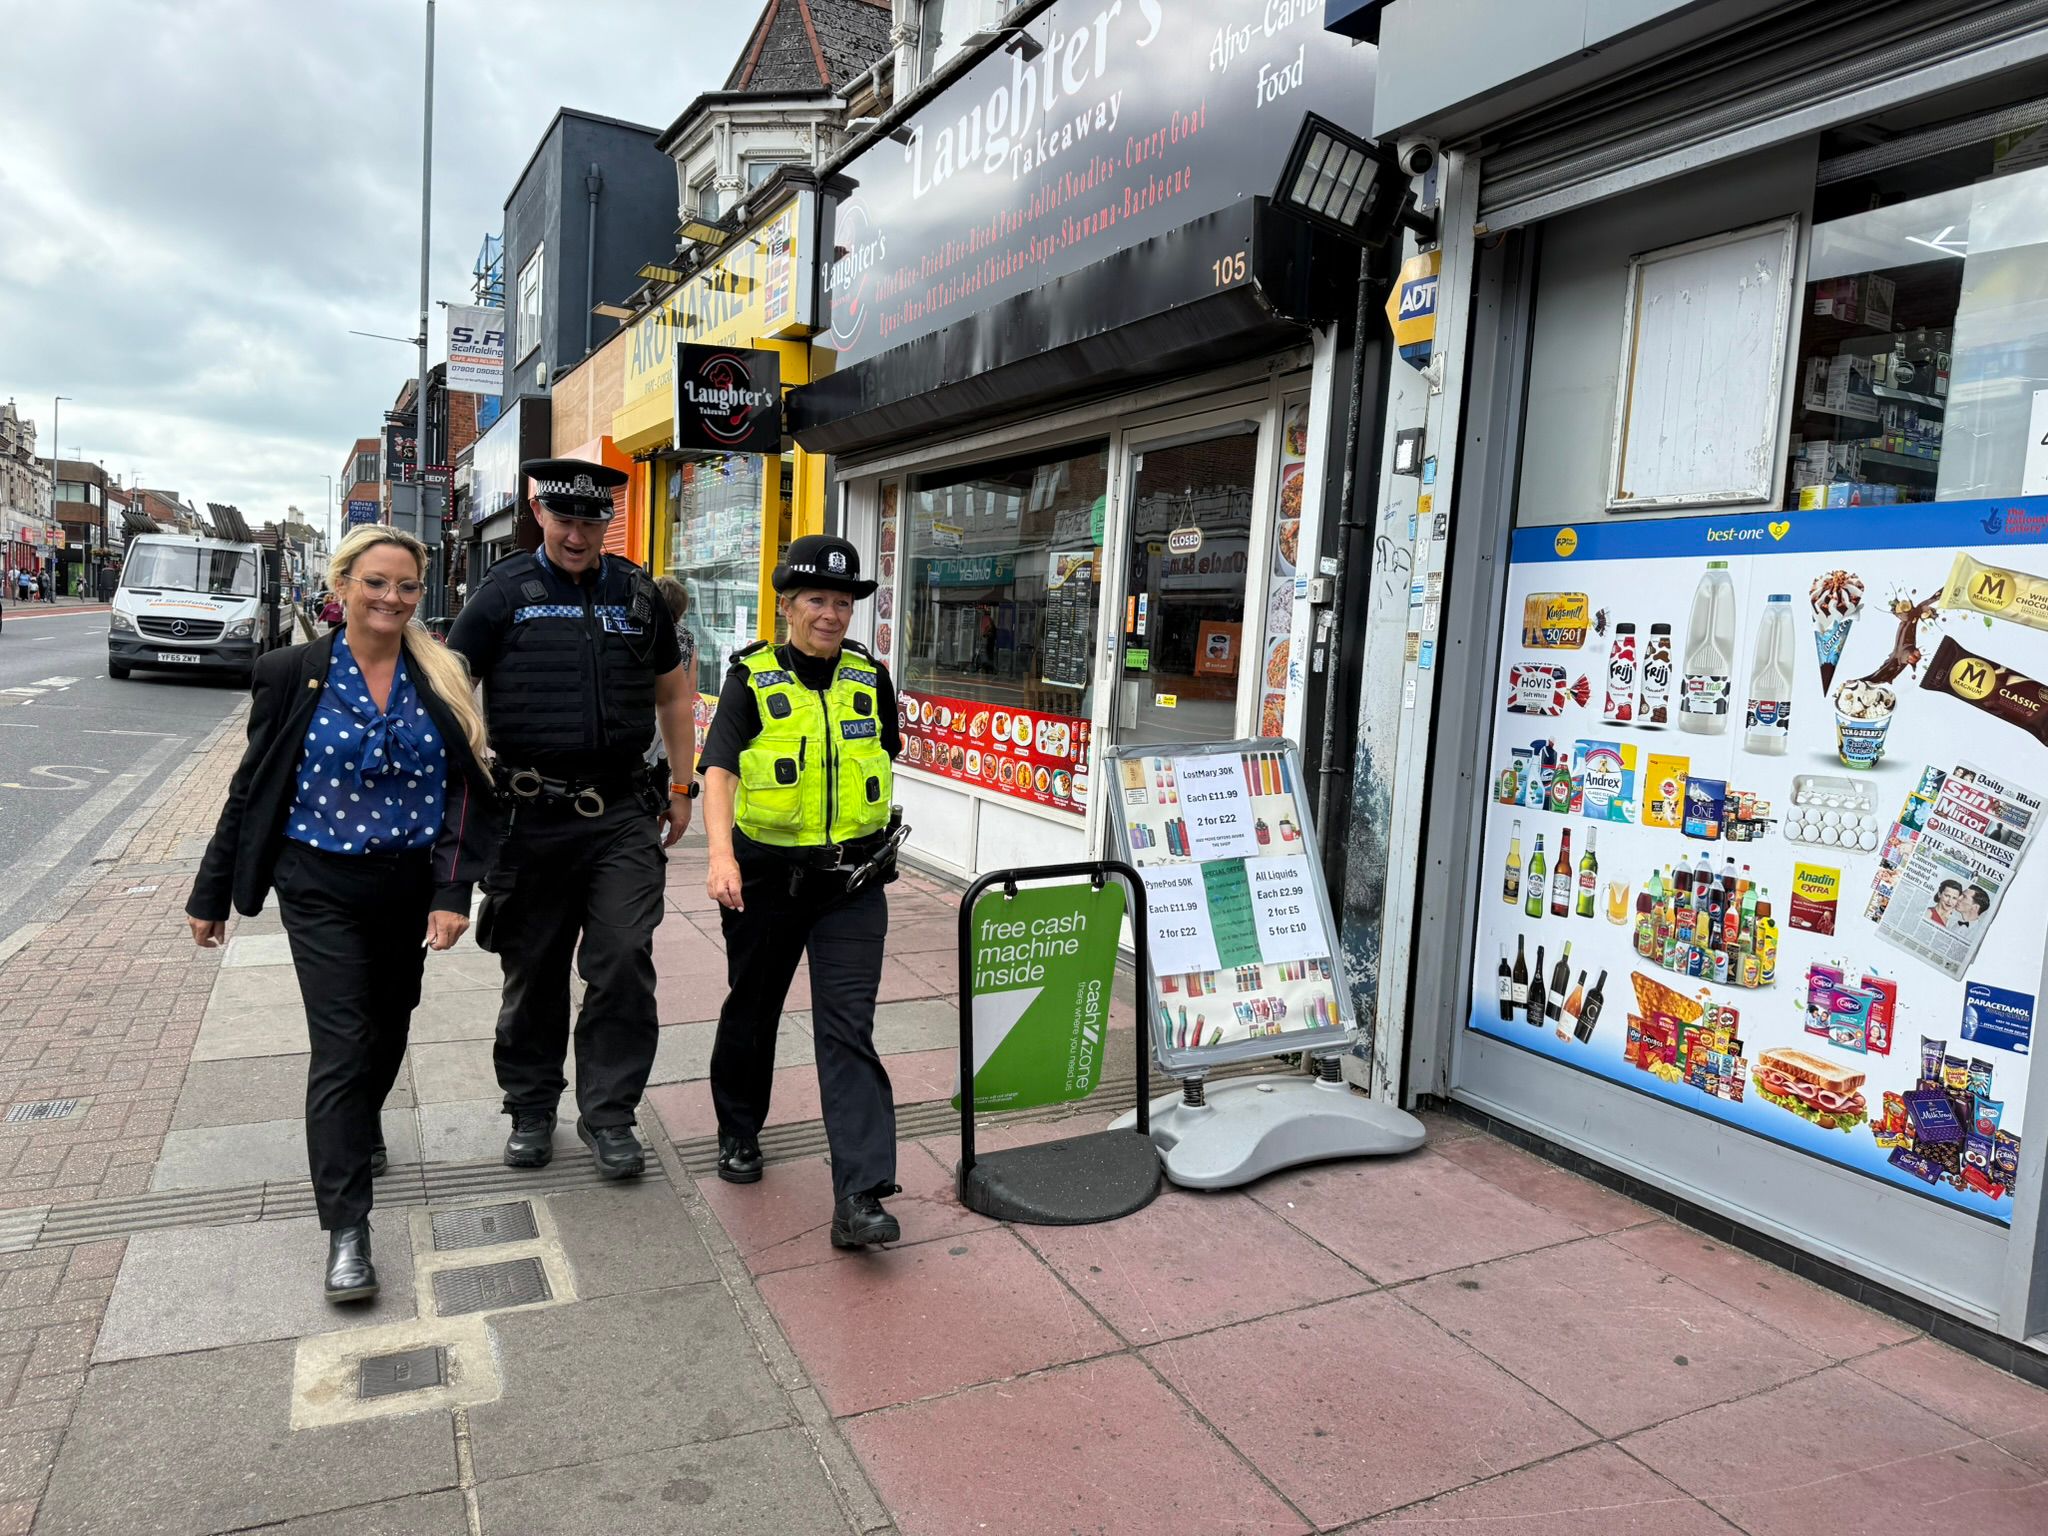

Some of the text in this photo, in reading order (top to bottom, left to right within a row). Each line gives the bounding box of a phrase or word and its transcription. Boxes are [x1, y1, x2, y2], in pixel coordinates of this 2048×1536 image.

[1256, 43, 1304, 109] Food
[1009, 89, 1123, 182] Takeaway
[1028, 175, 1063, 222] Jollof
[1064, 155, 1115, 202] Noodles
[1125, 127, 1167, 169] Curry
[1171, 97, 1207, 145] Goat
[984, 247, 1024, 287] Chicken
[1123, 165, 1191, 219] Barbecue
[821, 228, 887, 294] Laughter's
[1212, 251, 1246, 288] 105
[1399, 281, 1437, 316] ADT
[451, 343, 504, 358] Scaffolding
[684, 380, 773, 410] Laughter's
[1707, 526, 1765, 542] best-one
[2005, 525, 2041, 534] Lottery
[1171, 534, 1199, 547] CLOSED
[1972, 593, 2004, 607] MAGNUM
[1546, 604, 1584, 621] Kingsmill
[1546, 628, 1576, 645] 50/50
[1953, 678, 1983, 695] MAGNUM
[1533, 692, 1548, 700] White
[1999, 688, 2041, 712] CLASSIC
[843, 721, 875, 738] POLICE
[1183, 766, 1235, 780] LostMary 30K
[1585, 771, 1620, 789] Andrex
[1187, 789, 1238, 803] Each £11.99
[1943, 780, 1990, 812] Sun
[1976, 773, 2042, 810] Daily Mail
[1197, 813, 1237, 826] 2 for £22
[1691, 804, 1715, 819] ONE
[1937, 797, 1989, 834] Mirror
[1939, 822, 2015, 862] DAILY EXPRESS
[1921, 833, 2005, 882] THE TIMES
[1255, 868, 1298, 882] All Liquids
[1797, 870, 1836, 887] Anadin
[1906, 865, 1930, 881] troubled
[1145, 877, 1193, 890] PynePod 50K
[1801, 883, 1830, 895] EXTRA
[1902, 872, 1935, 892] charity fails
[1257, 886, 1304, 900] Each £2.99
[1149, 902, 1198, 914] Each £11.99
[1267, 905, 1300, 917] 2 for £5
[980, 910, 1087, 941] free cash
[1159, 926, 1197, 939] 2 for £22
[1268, 922, 1307, 936] 5 for £10
[977, 935, 1079, 965] machine
[974, 960, 1045, 989] inside
[1812, 977, 1833, 989] Calpol
[1838, 998, 1860, 1010] Calpol
[1966, 996, 2030, 1018] PARACETAMOL
[1065, 981, 1086, 1091] there where you need us
[1076, 979, 1101, 1089] cash zone
[1921, 1111, 1953, 1120] Milk Tray
[1899, 1154, 1929, 1172] Dairy Milk
